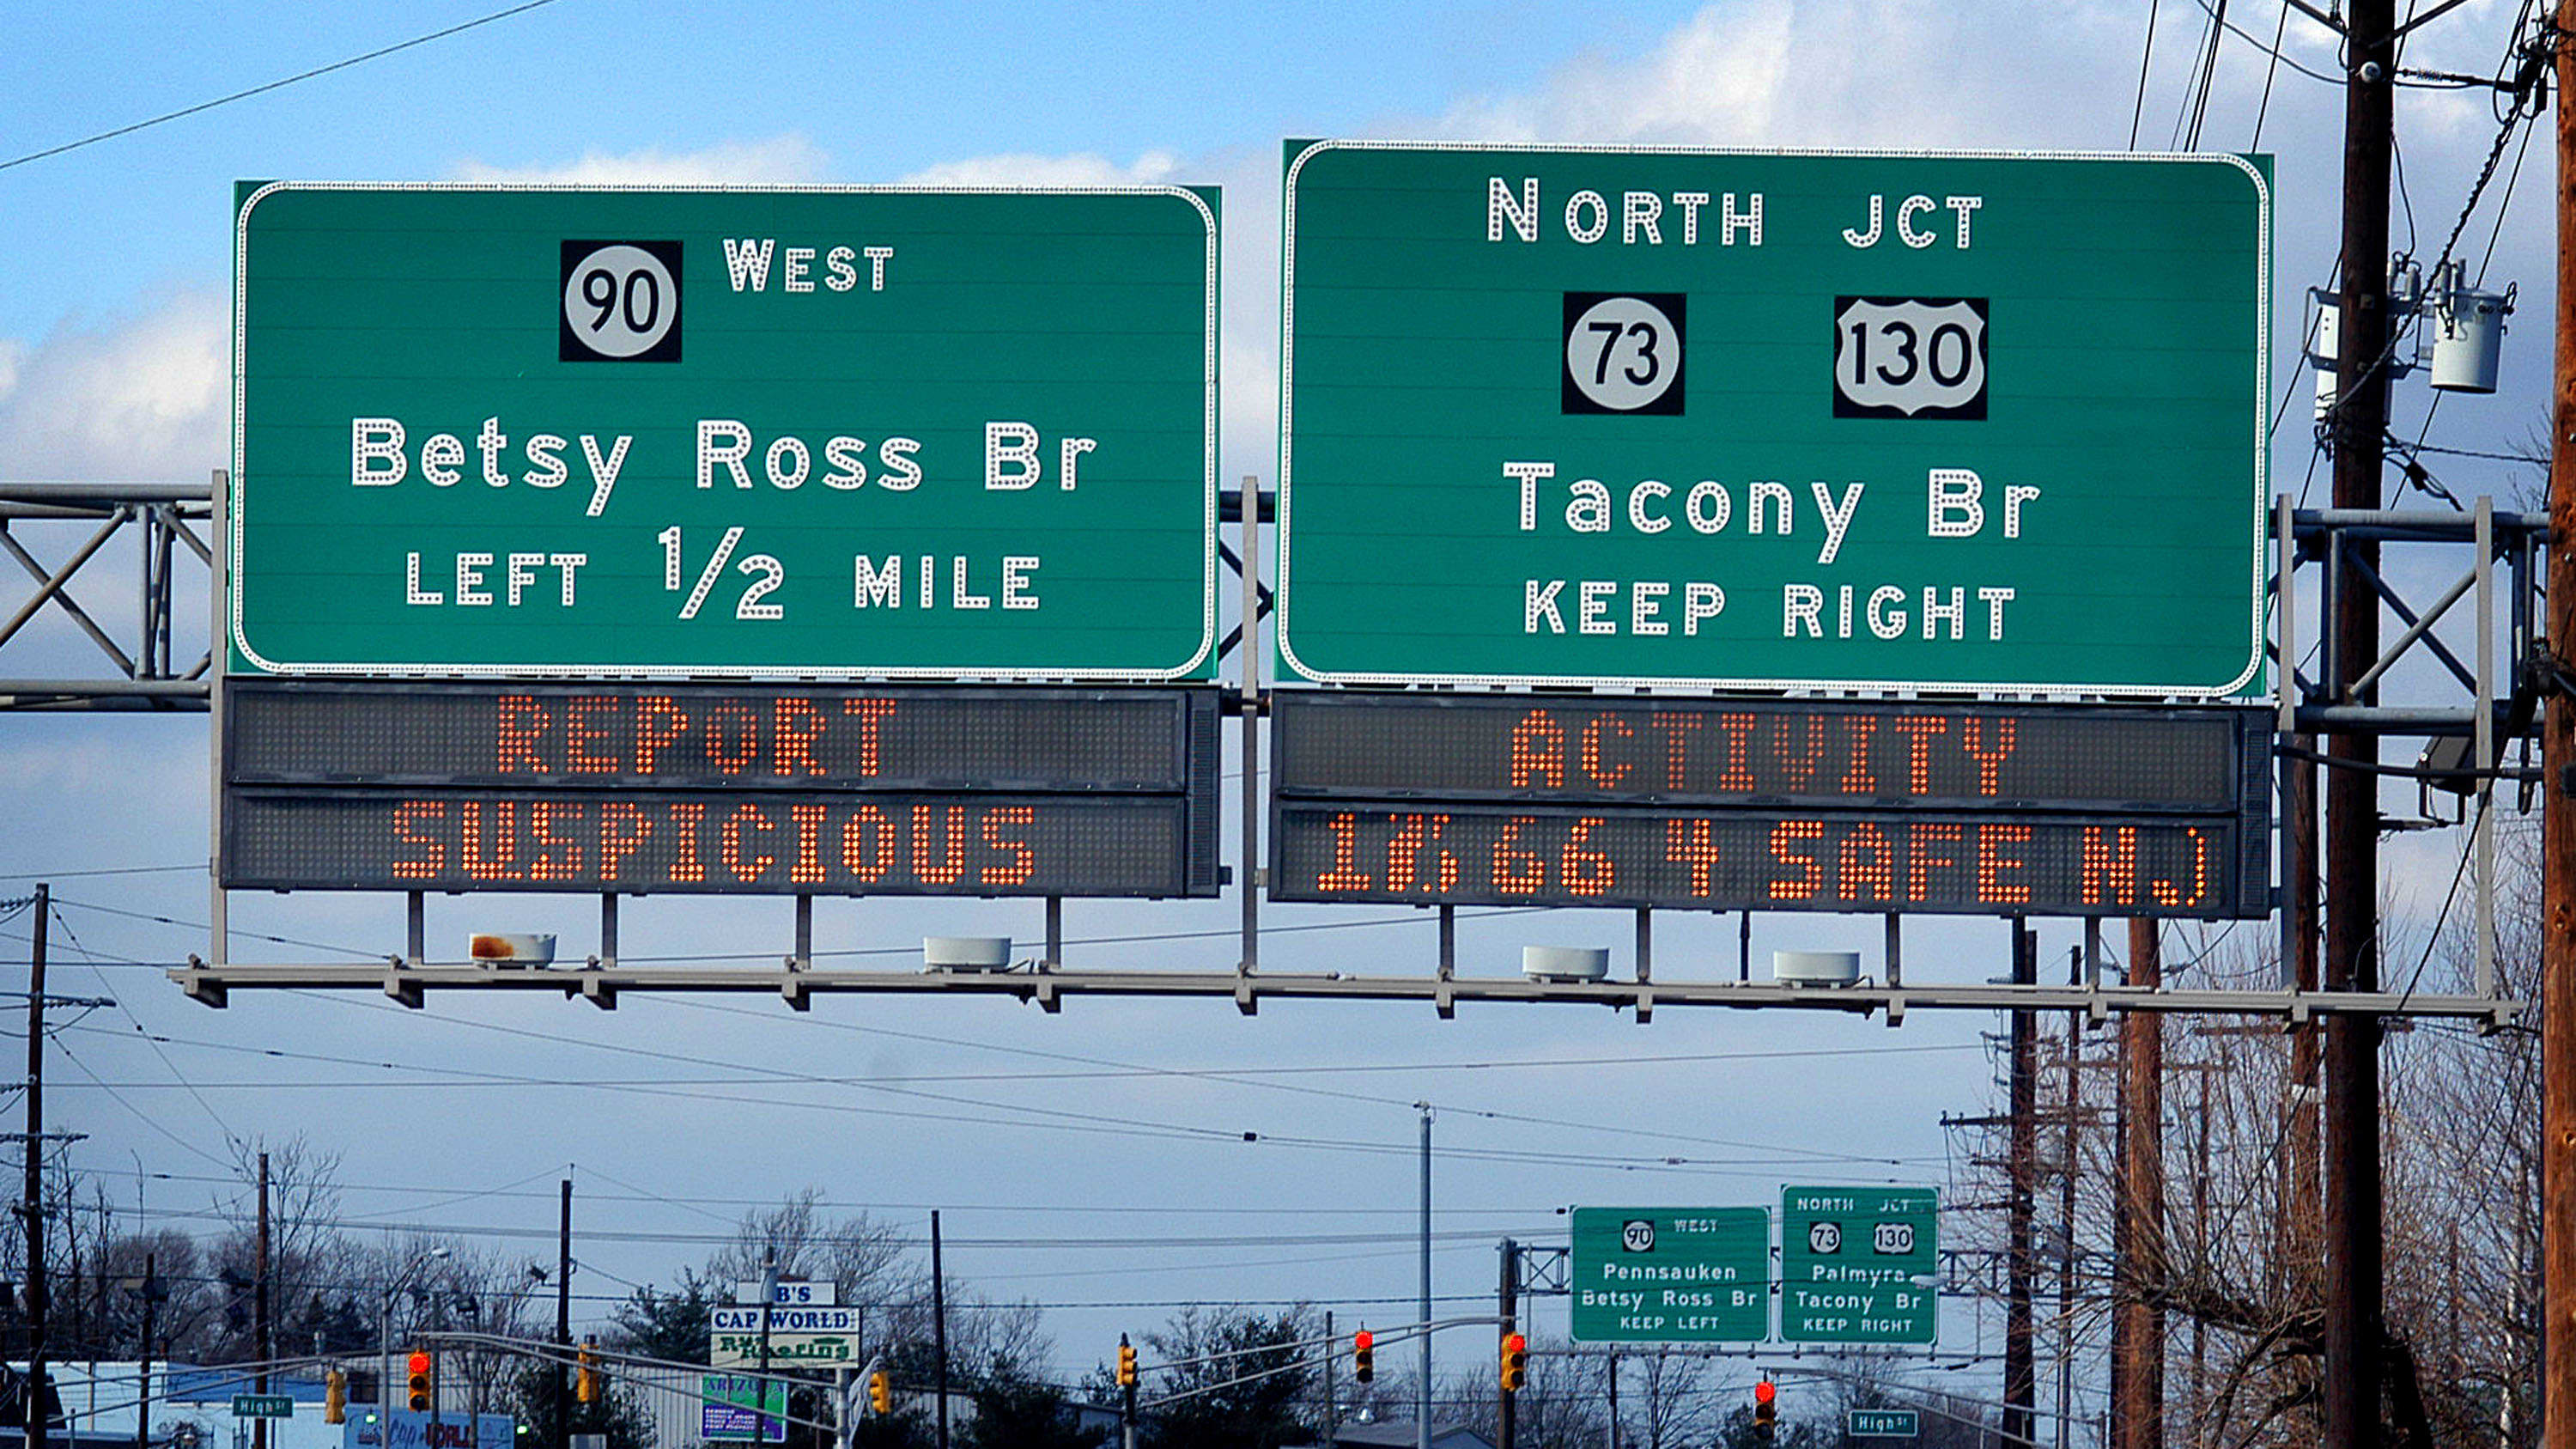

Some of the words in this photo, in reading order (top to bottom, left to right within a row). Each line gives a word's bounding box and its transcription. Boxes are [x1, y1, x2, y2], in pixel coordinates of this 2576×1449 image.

[1487, 177, 1764, 246] NORTH
[1842, 194, 1982, 249] JCT
[723, 239, 894, 293] WEST
[580, 267, 662, 334] 90
[1585, 320, 1661, 387] 73
[1851, 321, 1973, 387] 130
[352, 417, 633, 516] Betsy
[696, 419, 923, 491] Ross
[985, 422, 1097, 491] Br
[1503, 462, 1864, 564] Tacony
[1928, 468, 2041, 539] Br
[406, 551, 587, 606] LEFT
[854, 555, 1040, 610] MILE
[1525, 580, 1725, 636] KEEP
[1783, 584, 2015, 641] RIGHT
[497, 695, 896, 778] REPORT
[1511, 708, 2016, 796] ACTIVITY
[392, 801, 1035, 886] SUSPICIOUS
[1666, 818, 1718, 898] 4
[1769, 819, 2032, 904] SAFE
[1797, 1198, 1854, 1211] NORTH
[1878, 1199, 1909, 1212] JCT
[1627, 1228, 1652, 1245] 90
[1674, 1220, 1717, 1233] WEST
[1814, 1229, 1838, 1246] 73
[1877, 1229, 1911, 1247] 130
[1603, 1263, 1736, 1280] Pennsauken
[1812, 1264, 1905, 1288] Palmyra
[714, 1312, 758, 1329] CAP
[769, 1311, 848, 1329] WORLD
[1582, 1290, 1643, 1312] Betsy
[1662, 1290, 1714, 1306] Ross
[1731, 1290, 1757, 1306] Br
[1795, 1291, 1874, 1315] Tacony
[1895, 1293, 1922, 1309] Br
[1619, 1317, 1665, 1330] KEEP
[1678, 1317, 1719, 1330] LEFT
[1803, 1318, 1848, 1331] KEEP
[1862, 1318, 1912, 1332] RIGHT
[1859, 1416, 1894, 1432] High
